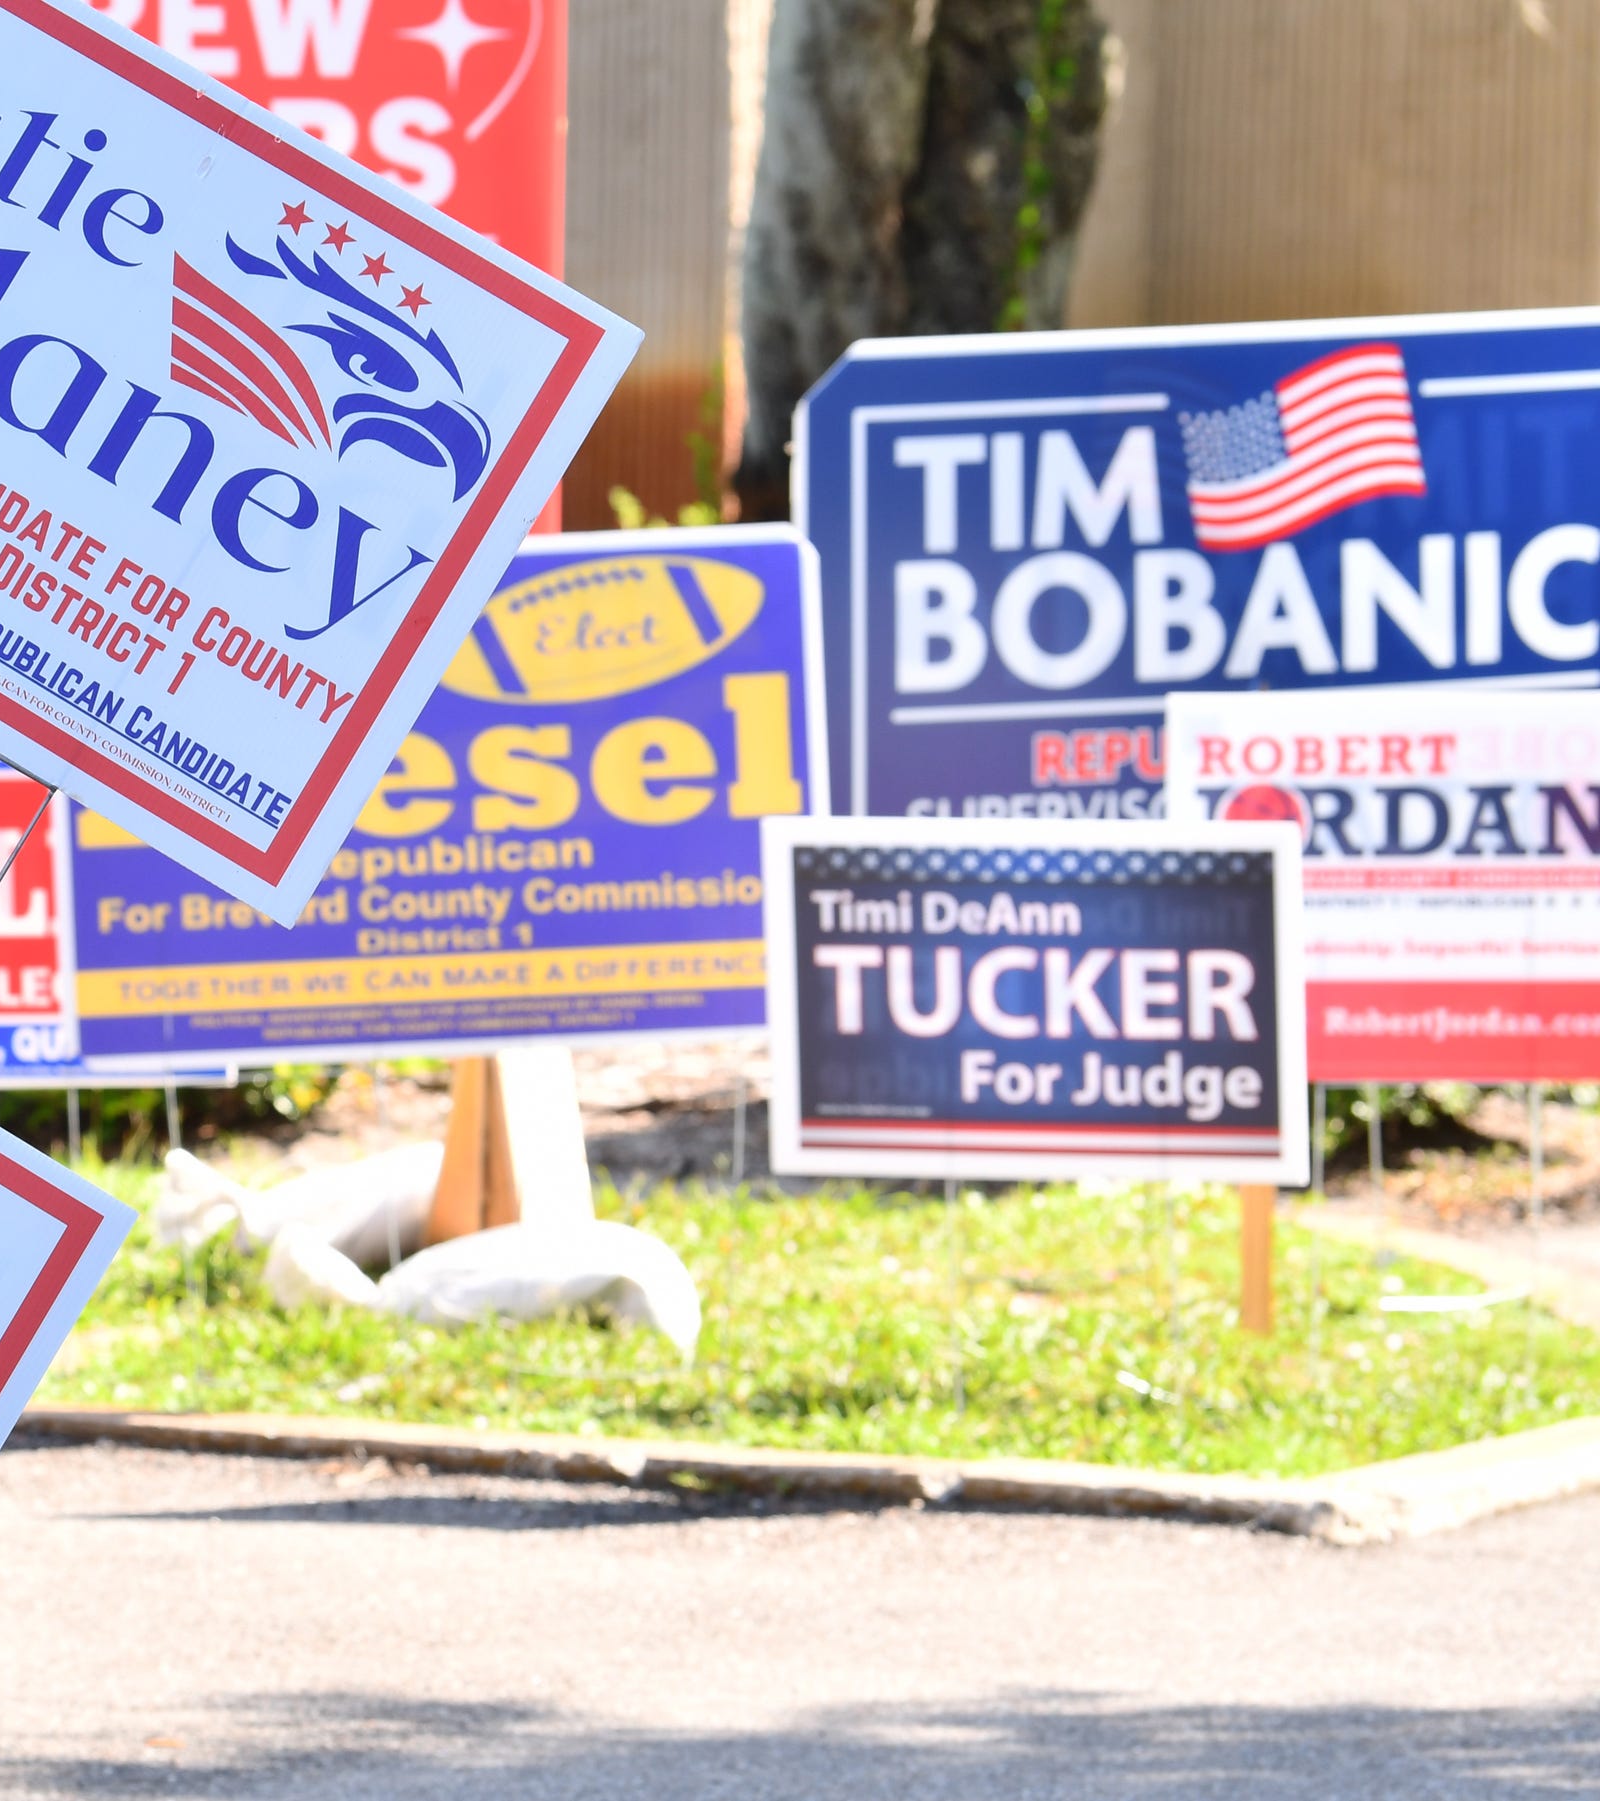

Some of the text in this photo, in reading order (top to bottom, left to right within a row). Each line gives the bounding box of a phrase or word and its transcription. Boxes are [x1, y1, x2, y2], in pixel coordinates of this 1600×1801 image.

[100, 0, 373, 78] EW
[894, 426, 1163, 554] TIM
[105, 558, 190, 632] FOR
[193, 607, 354, 723] COUNTY
[535, 610, 667, 655] Elect
[894, 524, 1600, 693] BOBANIC
[167, 652, 196, 695] 1
[30, 696, 53, 717] FOR
[53, 709, 101, 744] COUNTY
[100, 738, 172, 790] COMMISSION,
[173, 783, 227, 818] DISTRICT
[225, 812, 232, 824] 1
[124, 706, 292, 825] CANDIDATE
[1199, 734, 1457, 777] ROBERT
[325, 835, 593, 885] epublican
[97, 868, 763, 935] For Brerd County Commissio
[810, 889, 1083, 937] Timi DeAnn
[357, 922, 534, 954] District 1
[119, 976, 292, 1002] TOGETHER
[304, 973, 349, 994] WE
[364, 968, 432, 993] CAN
[442, 963, 531, 988] MAKE
[545, 963, 565, 983] A
[812, 943, 1260, 1041] TUCKER
[960, 1048, 1265, 1122] For Judge
